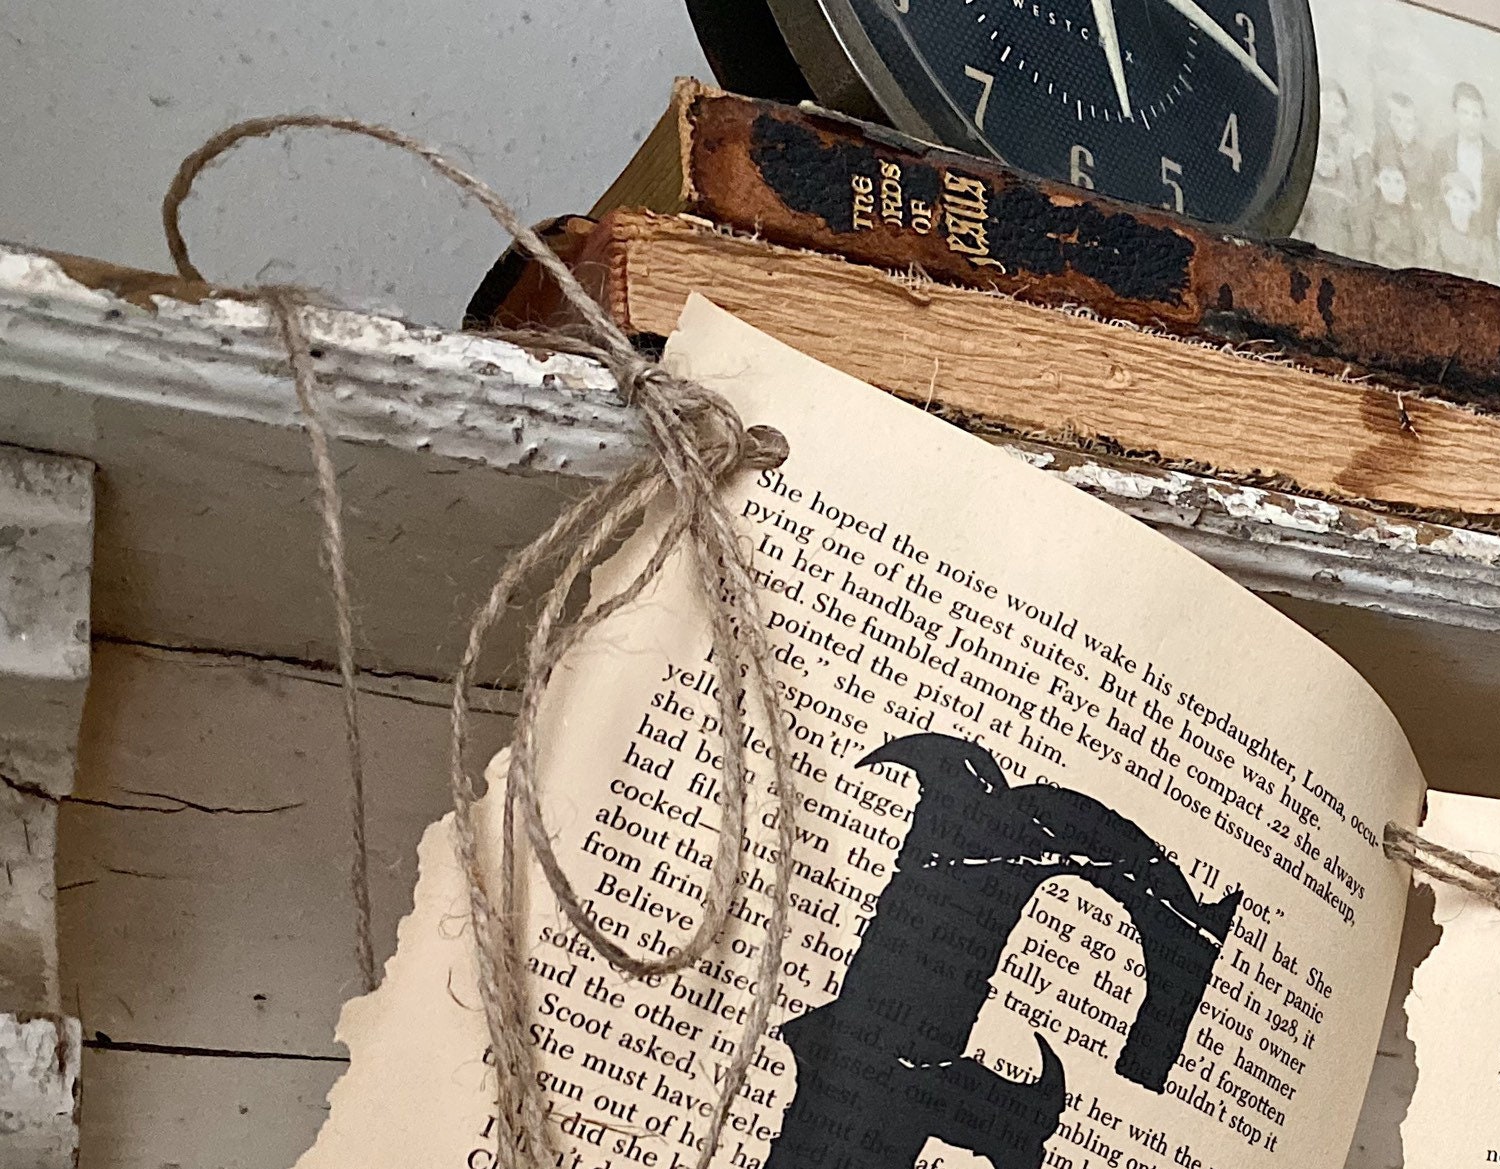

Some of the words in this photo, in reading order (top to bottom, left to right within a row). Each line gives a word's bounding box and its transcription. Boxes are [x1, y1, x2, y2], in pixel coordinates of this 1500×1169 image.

[1235, 12, 1258, 65] 3
[964, 65, 994, 131] 7
[1070, 144, 1095, 190] 6
[1218, 113, 1242, 173] 4
[1160, 156, 1185, 214] 5
[910, 199, 932, 235] OF
[740, 500, 815, 544] pying
[822, 537, 865, 565] one
[874, 563, 904, 582] of
[906, 574, 942, 604] the
[949, 601, 1014, 640] guest
[1020, 634, 1088, 680] suites.
[1098, 670, 1137, 708] But
[1143, 699, 1174, 730] the
[1179, 720, 1234, 768] house
[1244, 766, 1275, 795] was
[1279, 784, 1320, 830] huge.
[756, 468, 803, 503] She
[809, 490, 888, 542] hoped
[892, 534, 928, 564] the
[936, 560, 998, 599] noise
[1008, 594, 1078, 640] would
[1085, 634, 1136, 674] wake
[1142, 662, 1172, 696] his
[1177, 692, 1296, 782] stepdaughter,
[1302, 769, 1345, 822] Lorna,
[1351, 816, 1378, 847] occu-
[580, 831, 641, 873] from
[596, 805, 670, 850] about
[594, 872, 693, 930] Believe
